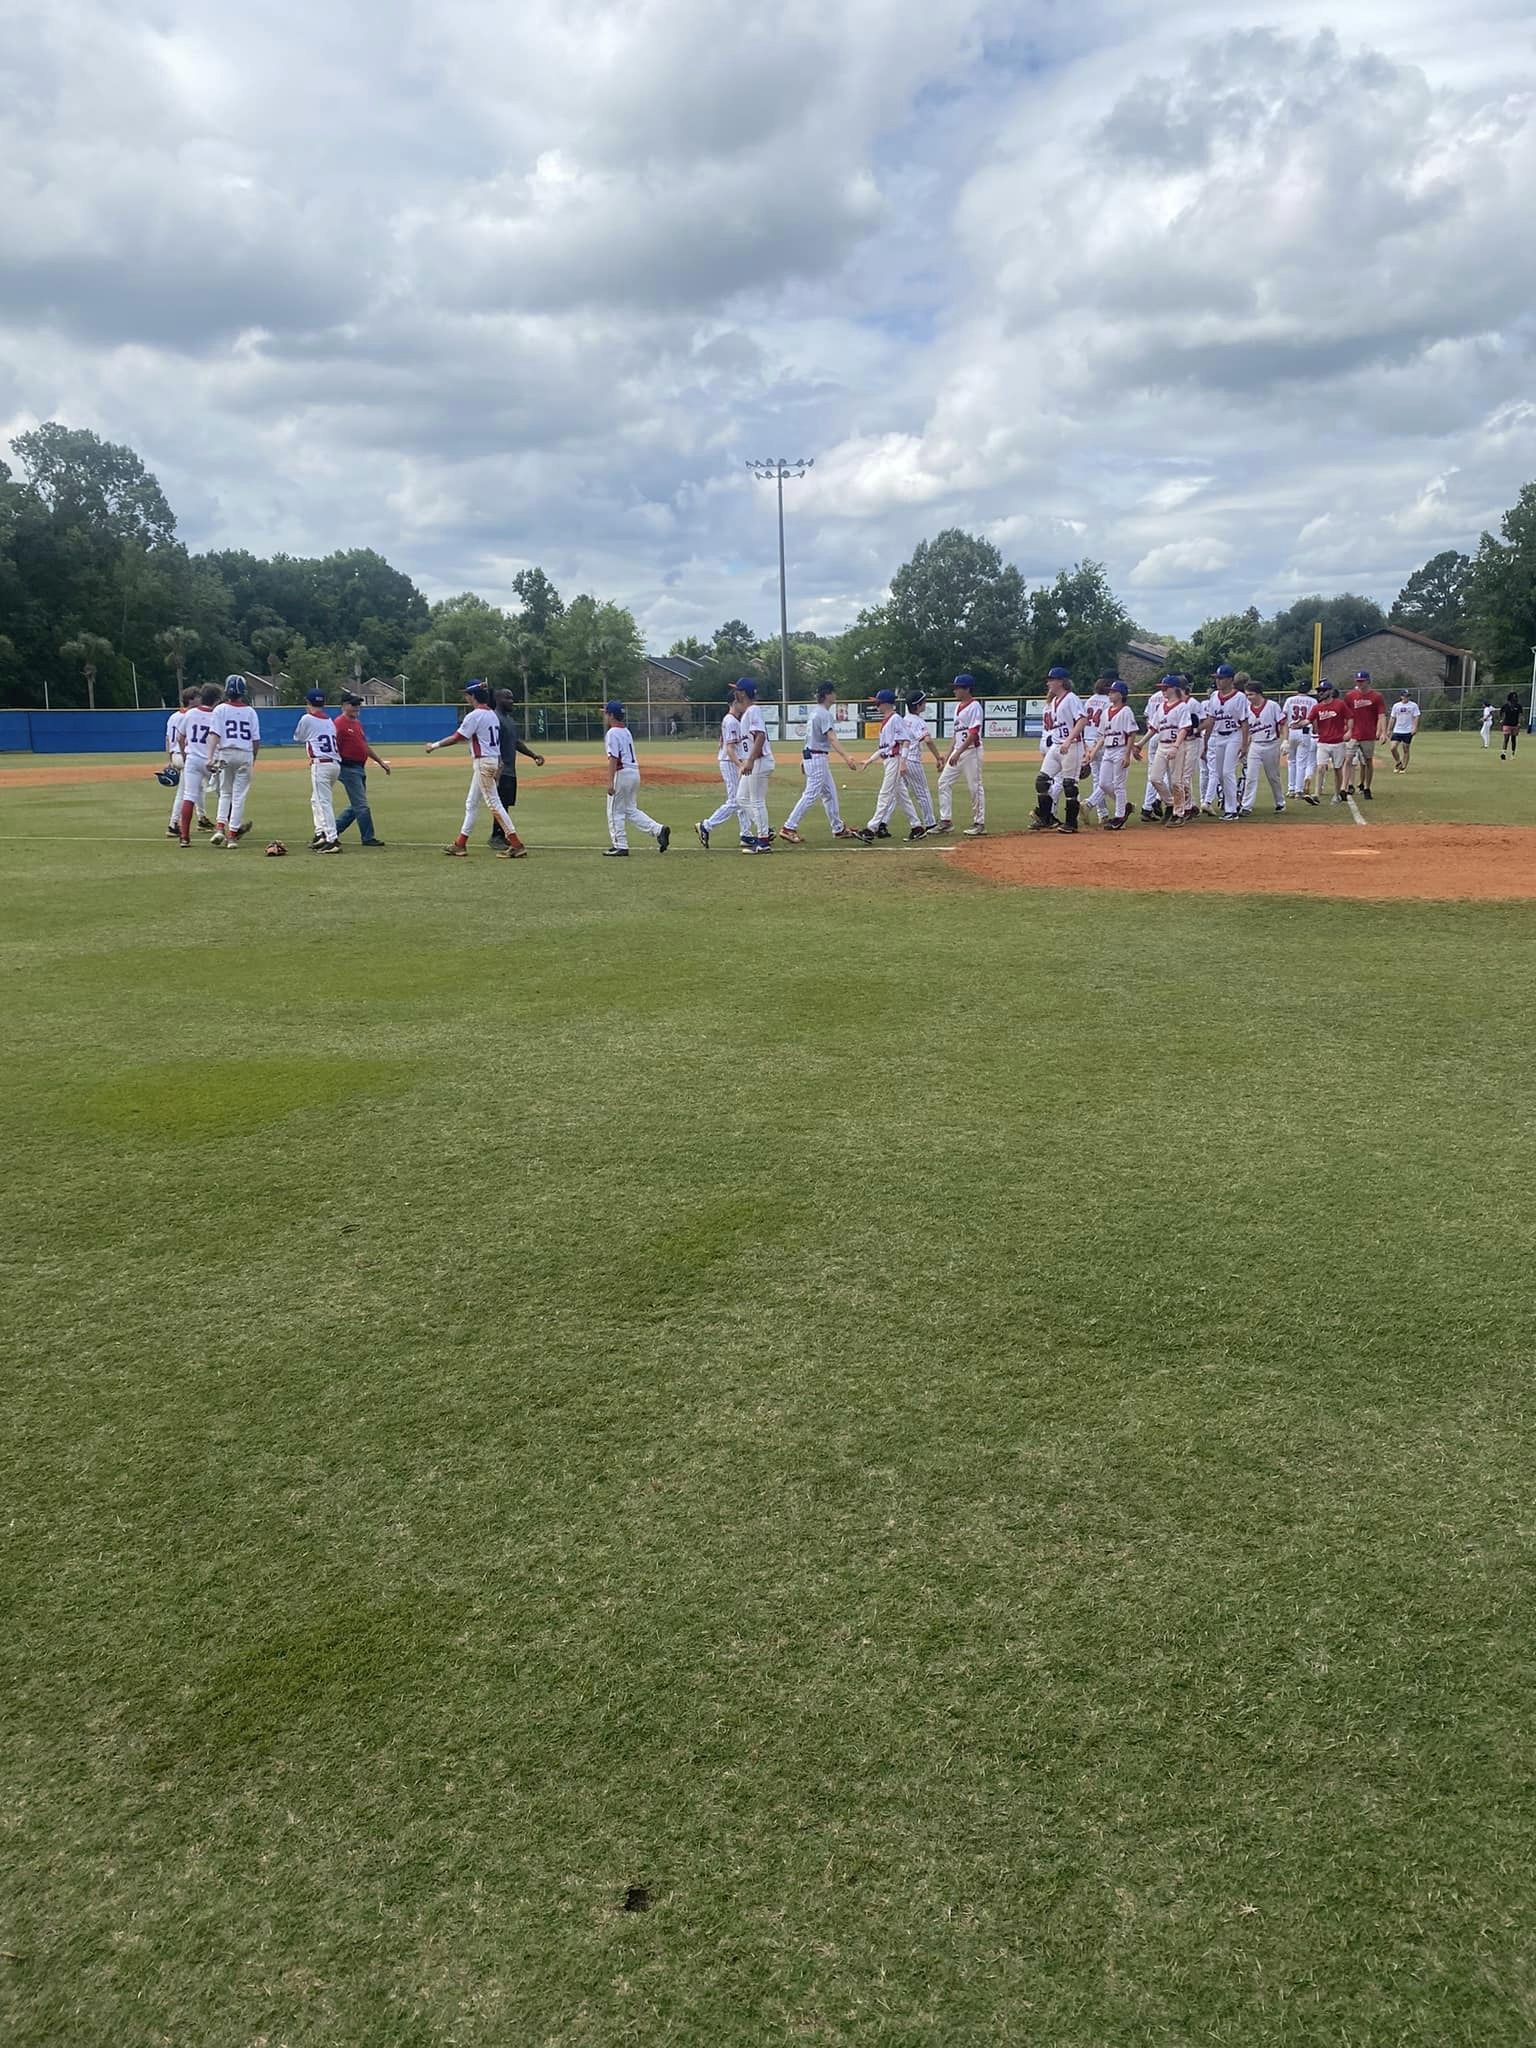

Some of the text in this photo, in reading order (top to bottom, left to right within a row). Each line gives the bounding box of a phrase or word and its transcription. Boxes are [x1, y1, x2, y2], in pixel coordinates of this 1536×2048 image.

[993, 704, 1017, 713] AMS
[1292, 705, 1308, 721] 33
[1086, 707, 1103, 728] 24
[191, 724, 210, 744] 17
[225, 720, 252, 740] 25
[1059, 727, 1070, 738] 19
[1112, 737, 1120, 747] 6
